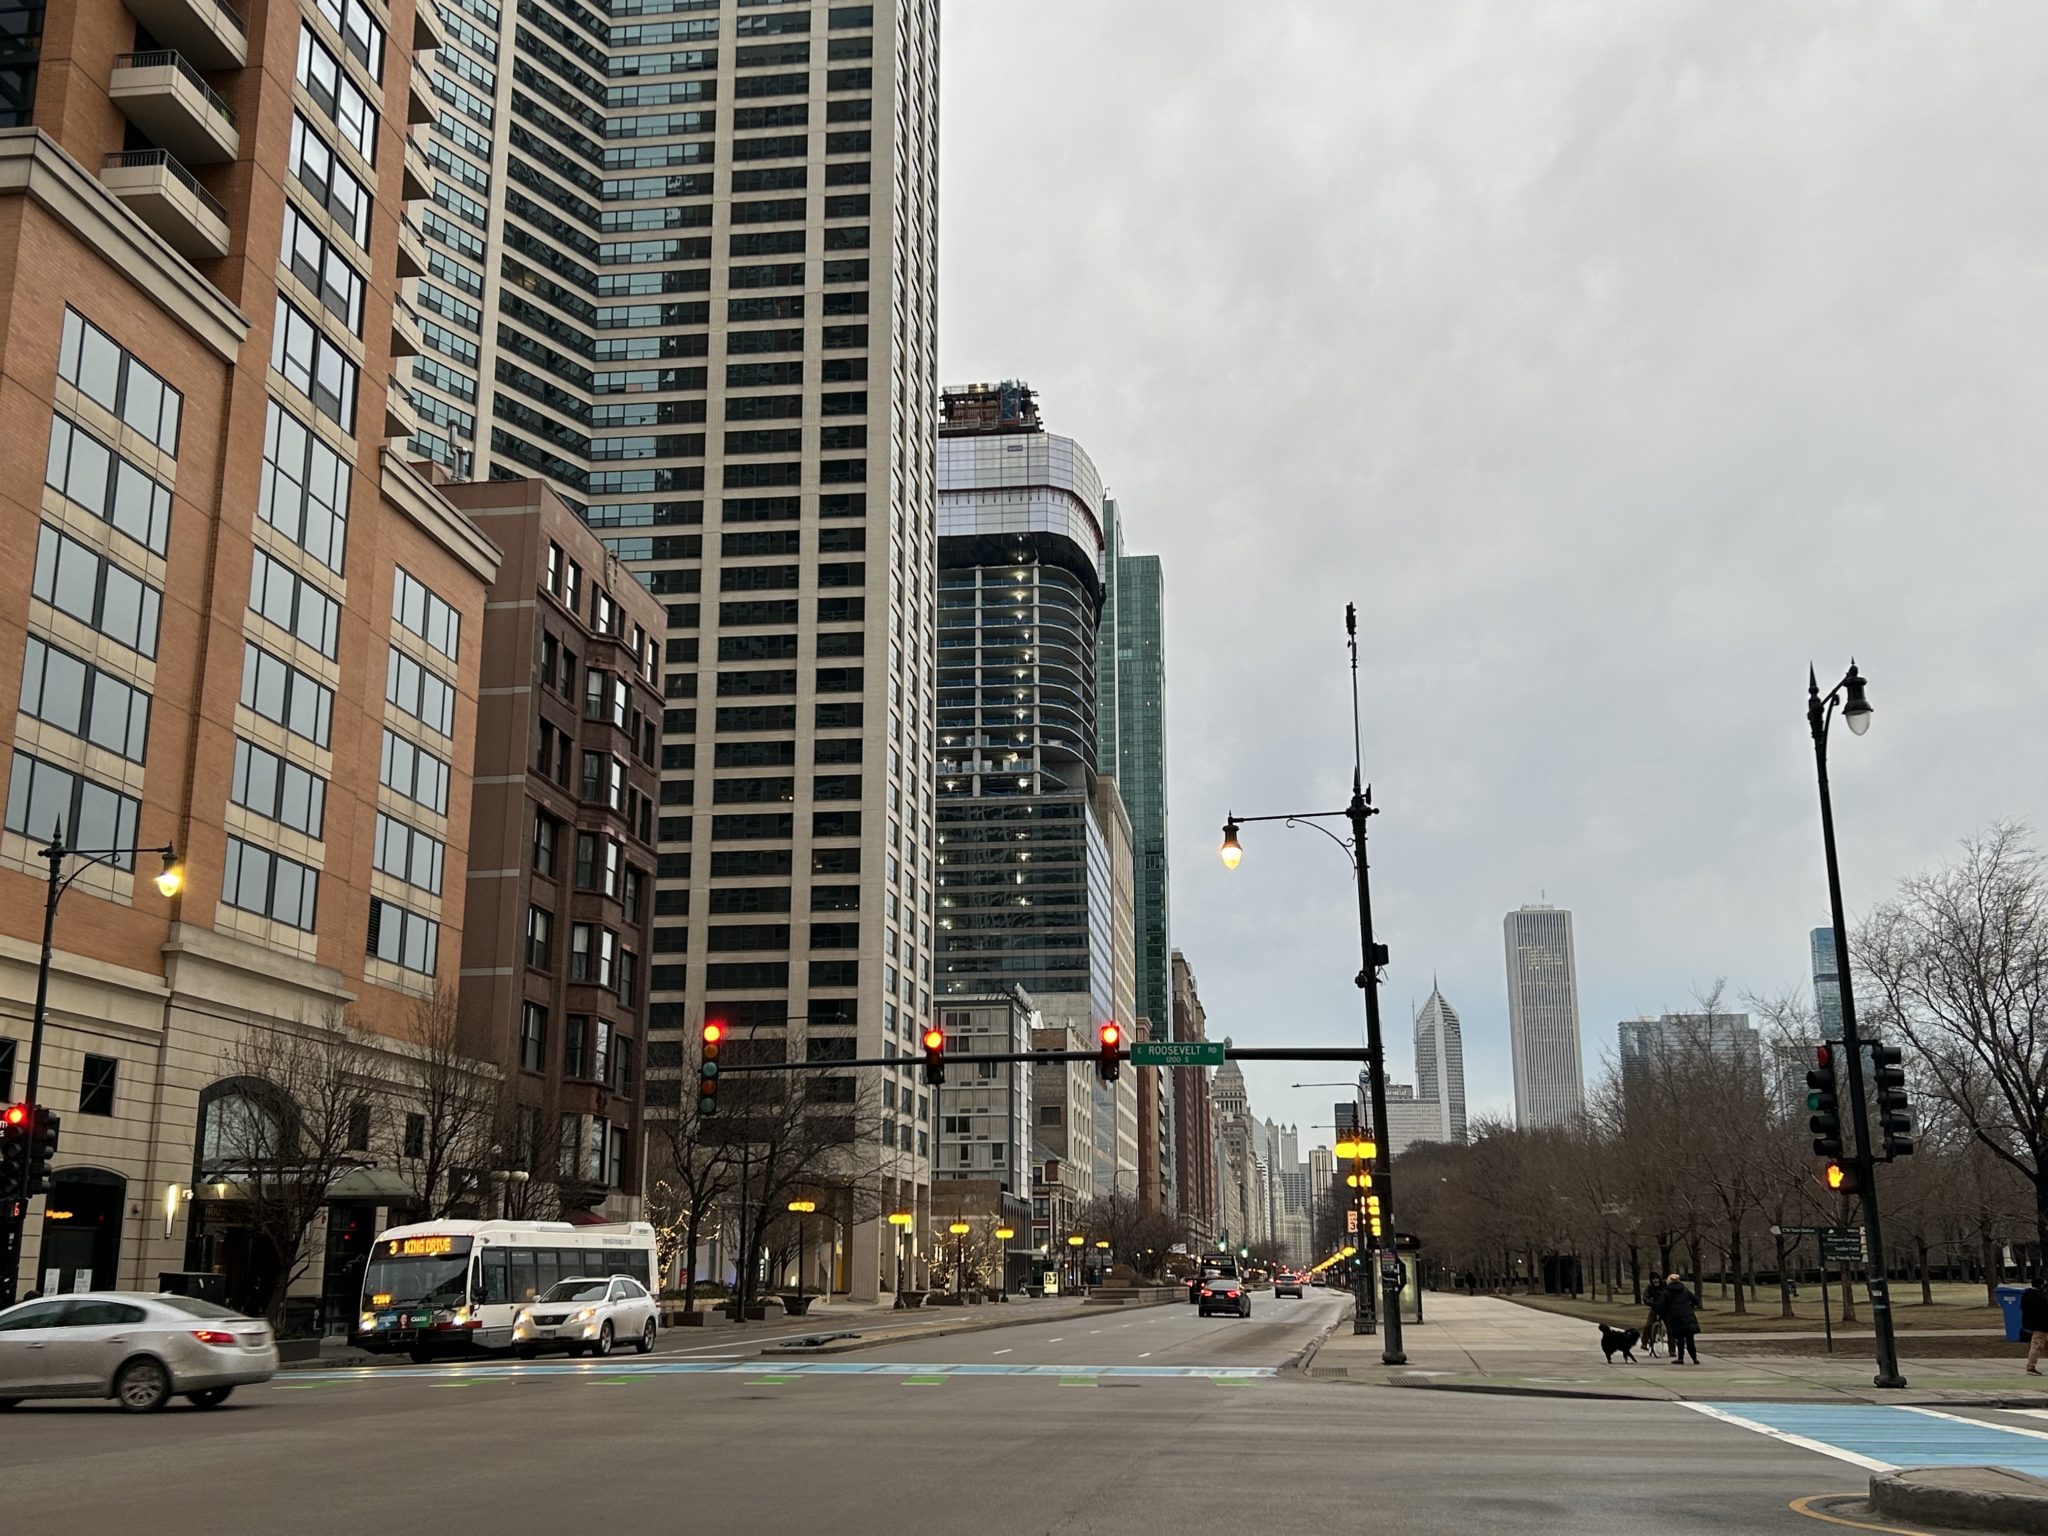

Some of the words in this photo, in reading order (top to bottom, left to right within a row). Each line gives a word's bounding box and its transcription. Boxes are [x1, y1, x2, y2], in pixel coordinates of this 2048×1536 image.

[1148, 1045, 1201, 1055] ROOSEVELT
[1207, 1046, 1217, 1054] RD
[389, 1241, 398, 1255] 3
[404, 1239, 424, 1254] KING
[425, 1237, 452, 1252] DRIVE
